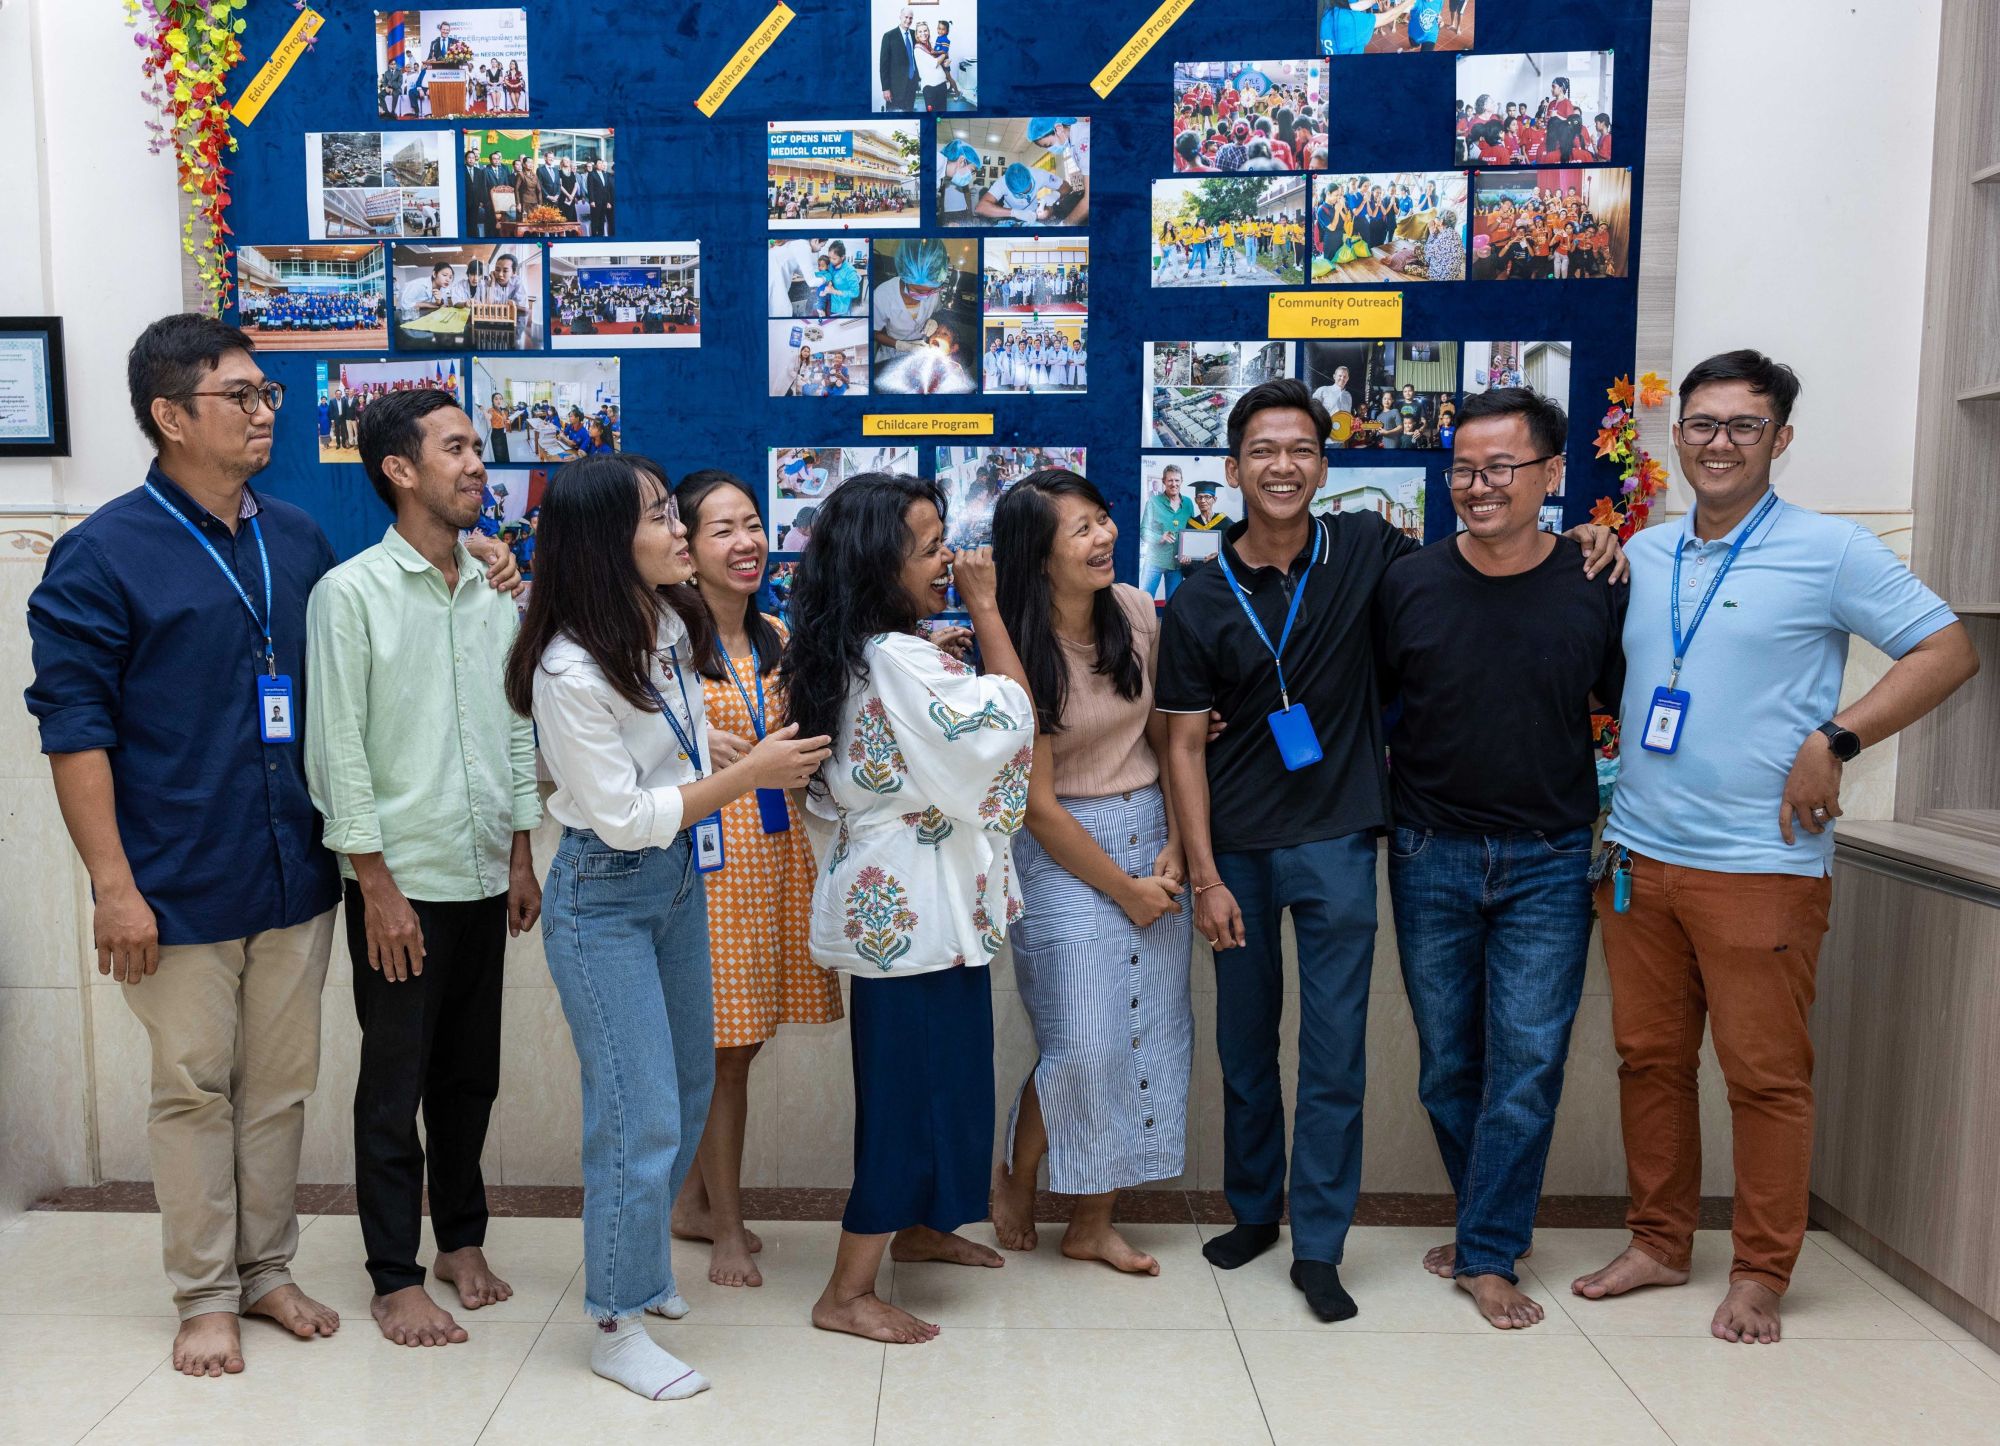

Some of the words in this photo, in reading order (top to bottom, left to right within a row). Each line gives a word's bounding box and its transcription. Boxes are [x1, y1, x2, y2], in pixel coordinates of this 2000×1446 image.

[705, 55, 750, 106] Healthcare
[747, 15, 785, 55] Program
[1100, 36, 1149, 88] Leadership
[248, 56, 287, 103] Education
[771, 135, 788, 143] CCF
[790, 134, 819, 143] OPENS
[822, 134, 842, 142] NEW
[771, 147, 809, 156] MEDICAL
[812, 146, 847, 155] CENTRE
[1278, 297, 1344, 309] Community
[1347, 297, 1400, 308] Outreach
[1311, 316, 1359, 329] Program
[877, 419, 929, 430] Childcare
[931, 419, 979, 431] Program
